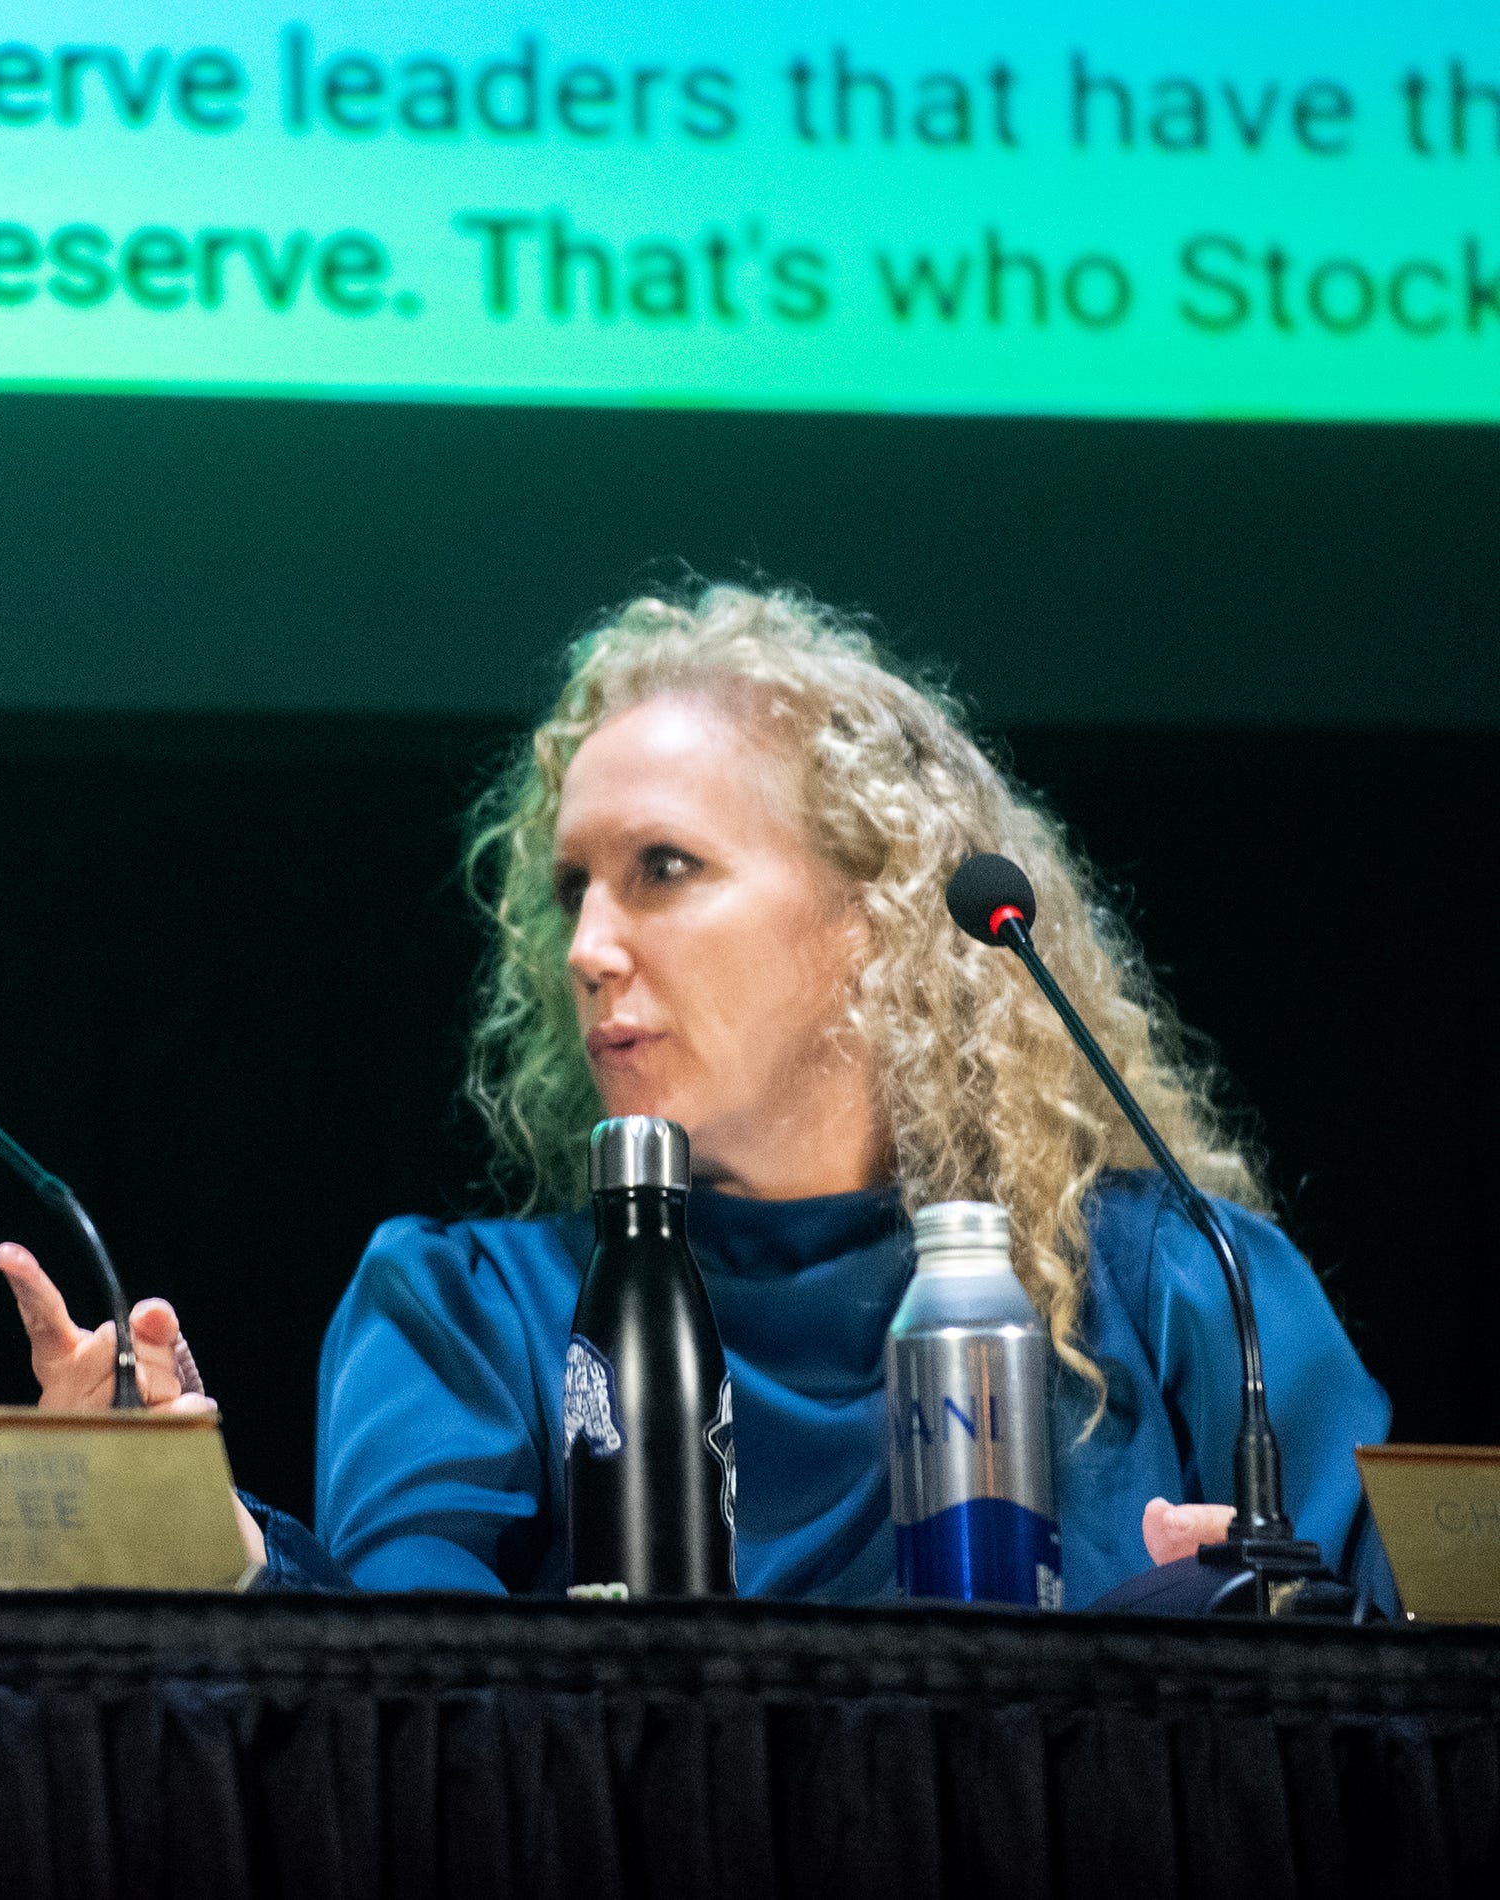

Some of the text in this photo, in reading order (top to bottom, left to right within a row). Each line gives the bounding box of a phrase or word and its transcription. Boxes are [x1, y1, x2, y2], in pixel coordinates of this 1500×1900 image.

[284, 24, 739, 137] leaders
[783, 44, 1020, 148] that
[1070, 49, 1355, 157] have
[1400, 57, 1500, 158] th
[455, 211, 828, 323] That's
[877, 227, 1132, 331] who
[1179, 233, 1500, 335] Stock
